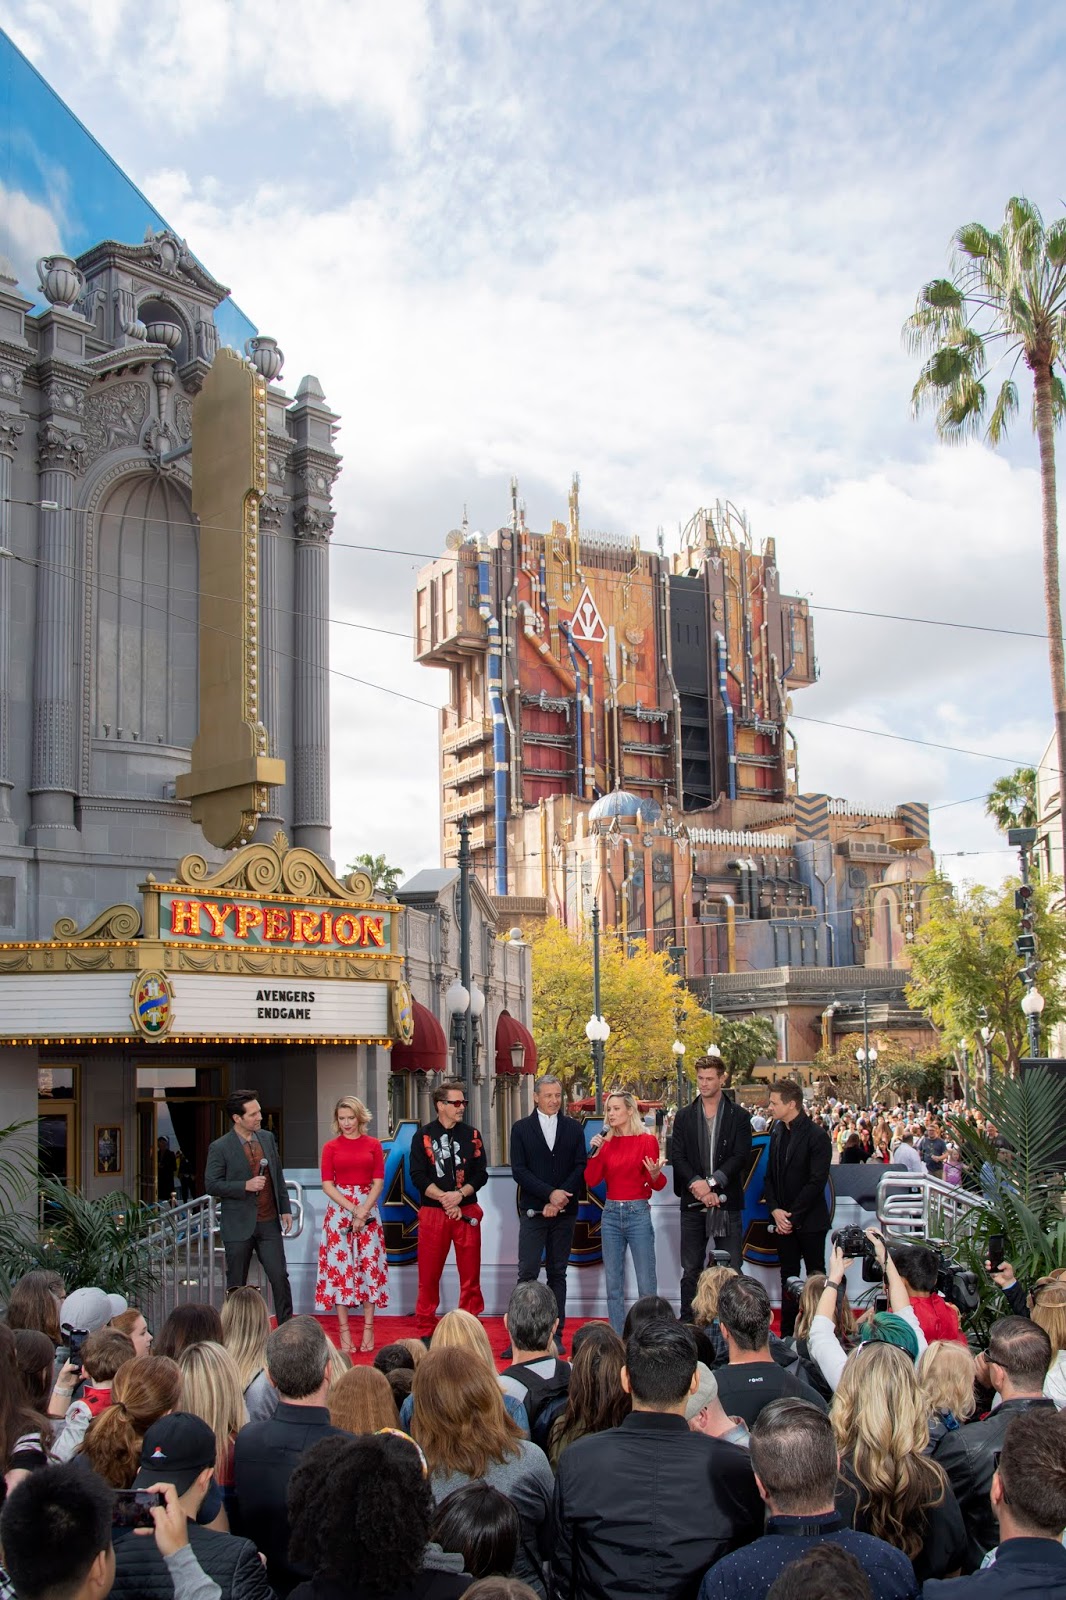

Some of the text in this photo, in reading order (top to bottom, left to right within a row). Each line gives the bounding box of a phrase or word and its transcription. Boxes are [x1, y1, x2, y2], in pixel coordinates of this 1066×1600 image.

[171, 899, 385, 948] HYPERION
[256, 989, 316, 1003] AVENGERS
[257, 1007, 311, 1020] ENDGAME
